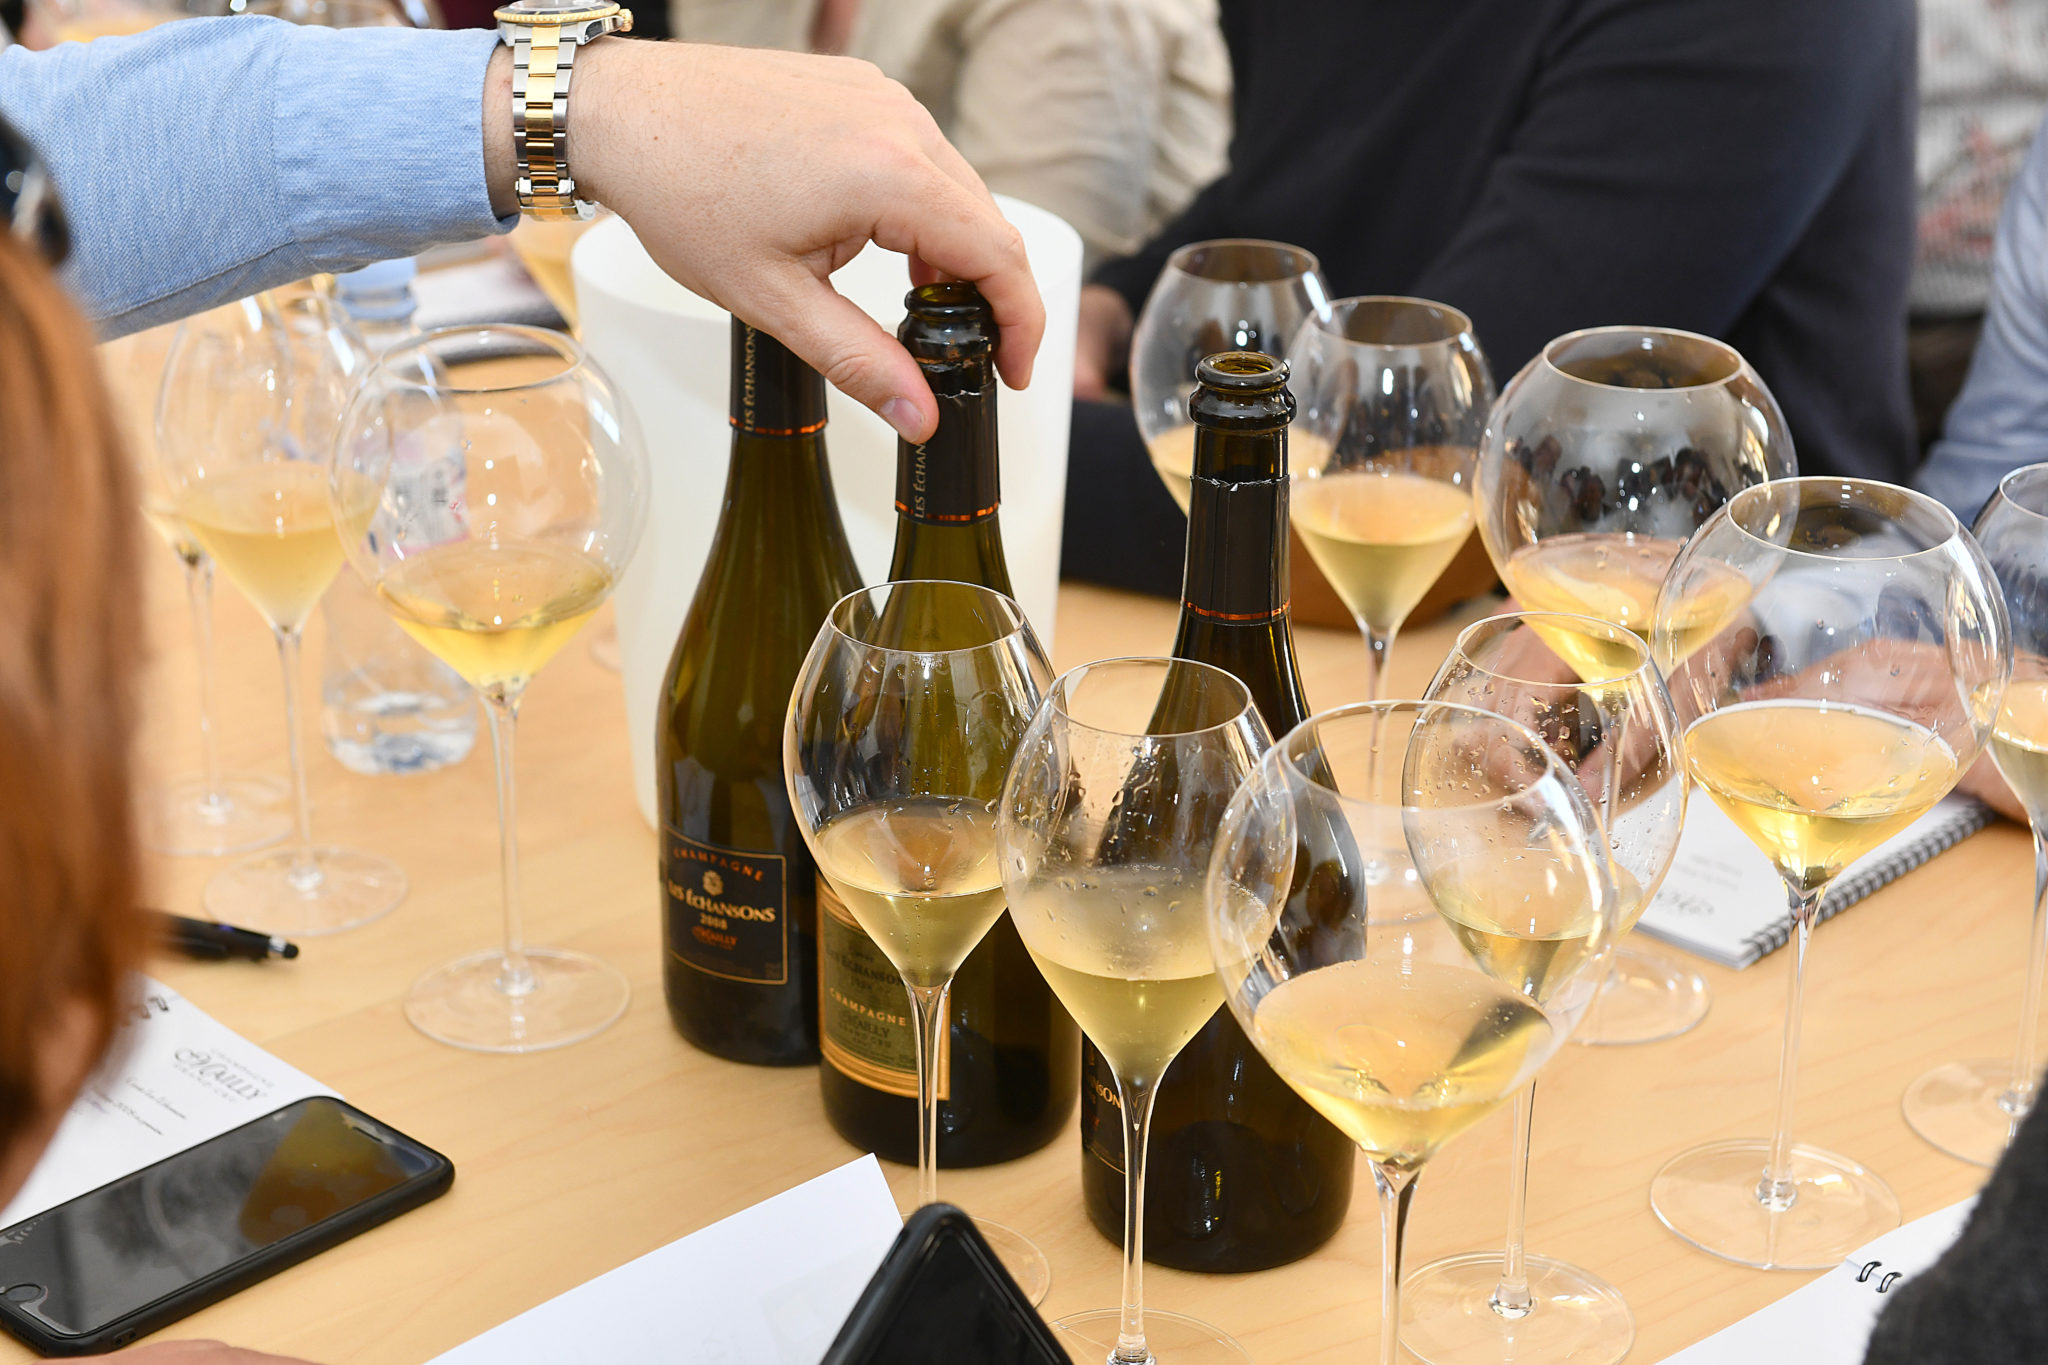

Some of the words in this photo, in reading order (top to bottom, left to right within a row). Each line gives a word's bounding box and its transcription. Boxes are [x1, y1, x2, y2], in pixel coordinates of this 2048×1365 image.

[913, 442, 927, 493] ÉCHAN
[914, 496, 926, 519] LES
[673, 847, 764, 882] CHAMPAGNE
[685, 888, 777, 923] ÉCHANSONS
[829, 986, 907, 1027] CHAMPAGNE
